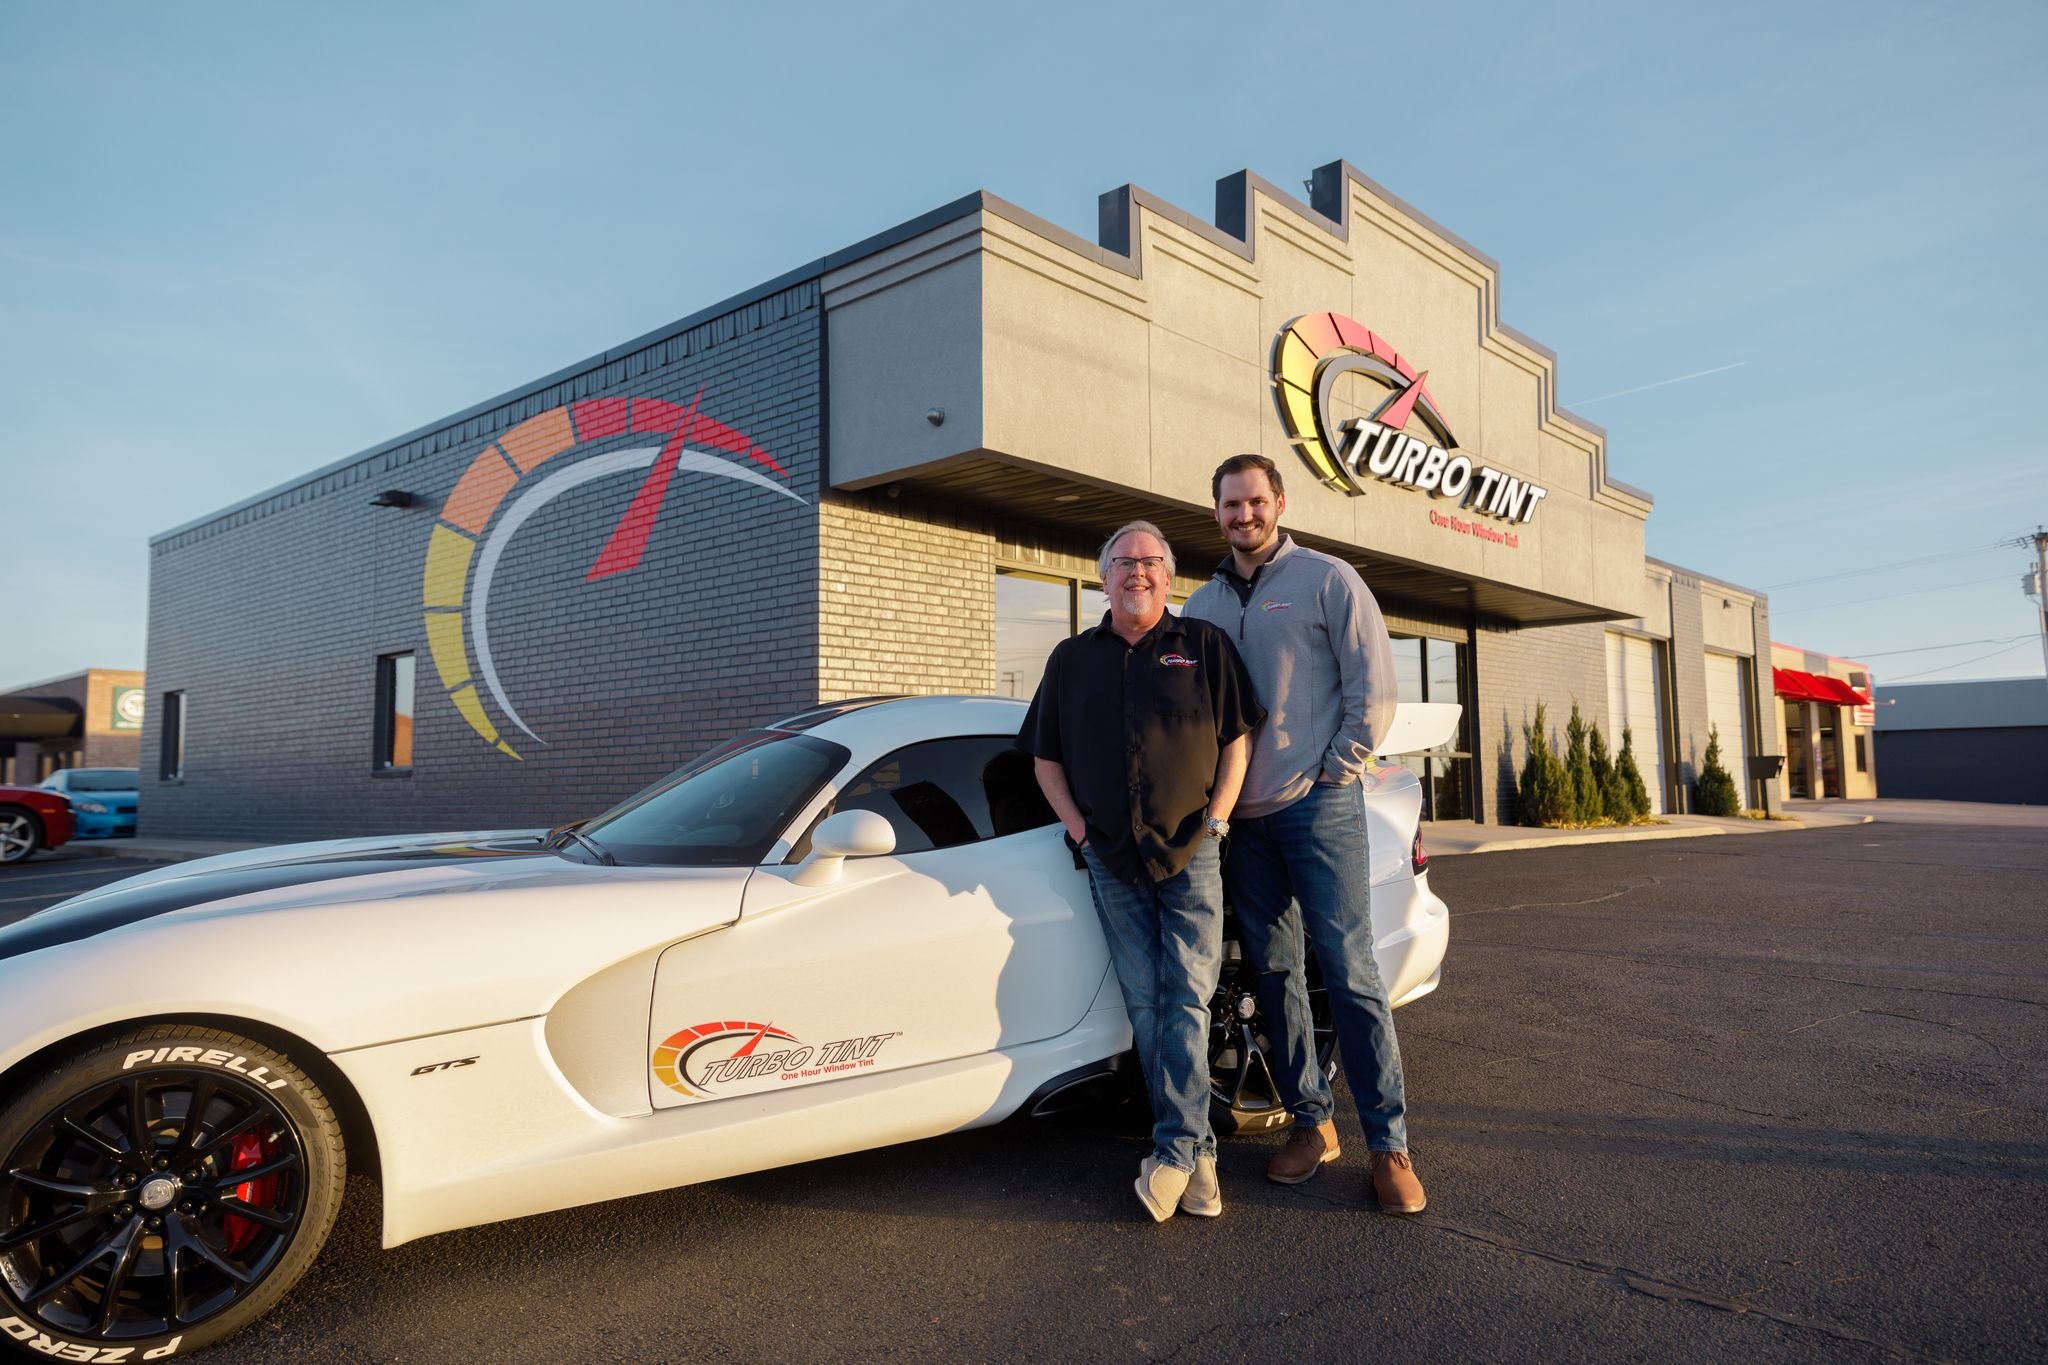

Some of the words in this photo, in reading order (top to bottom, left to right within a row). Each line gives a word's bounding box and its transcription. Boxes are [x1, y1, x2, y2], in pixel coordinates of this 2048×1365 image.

[1345, 417, 1473, 498] TURBO
[1474, 465, 1548, 524] TINT
[1429, 509, 1449, 528] One
[1471, 522, 1504, 544] Window
[122, 1046, 288, 1090] PIRELLI
[410, 1055, 480, 1076] GTS
[698, 1046, 813, 1086] TURBO
[815, 1032, 895, 1066] TINT
[781, 1070, 799, 1081] One
[801, 1067, 822, 1078] Hour
[823, 1063, 856, 1074] Window
[857, 1058, 874, 1069] Tint
[0, 1316, 136, 1364] ZERO
[143, 1335, 183, 1360] P
